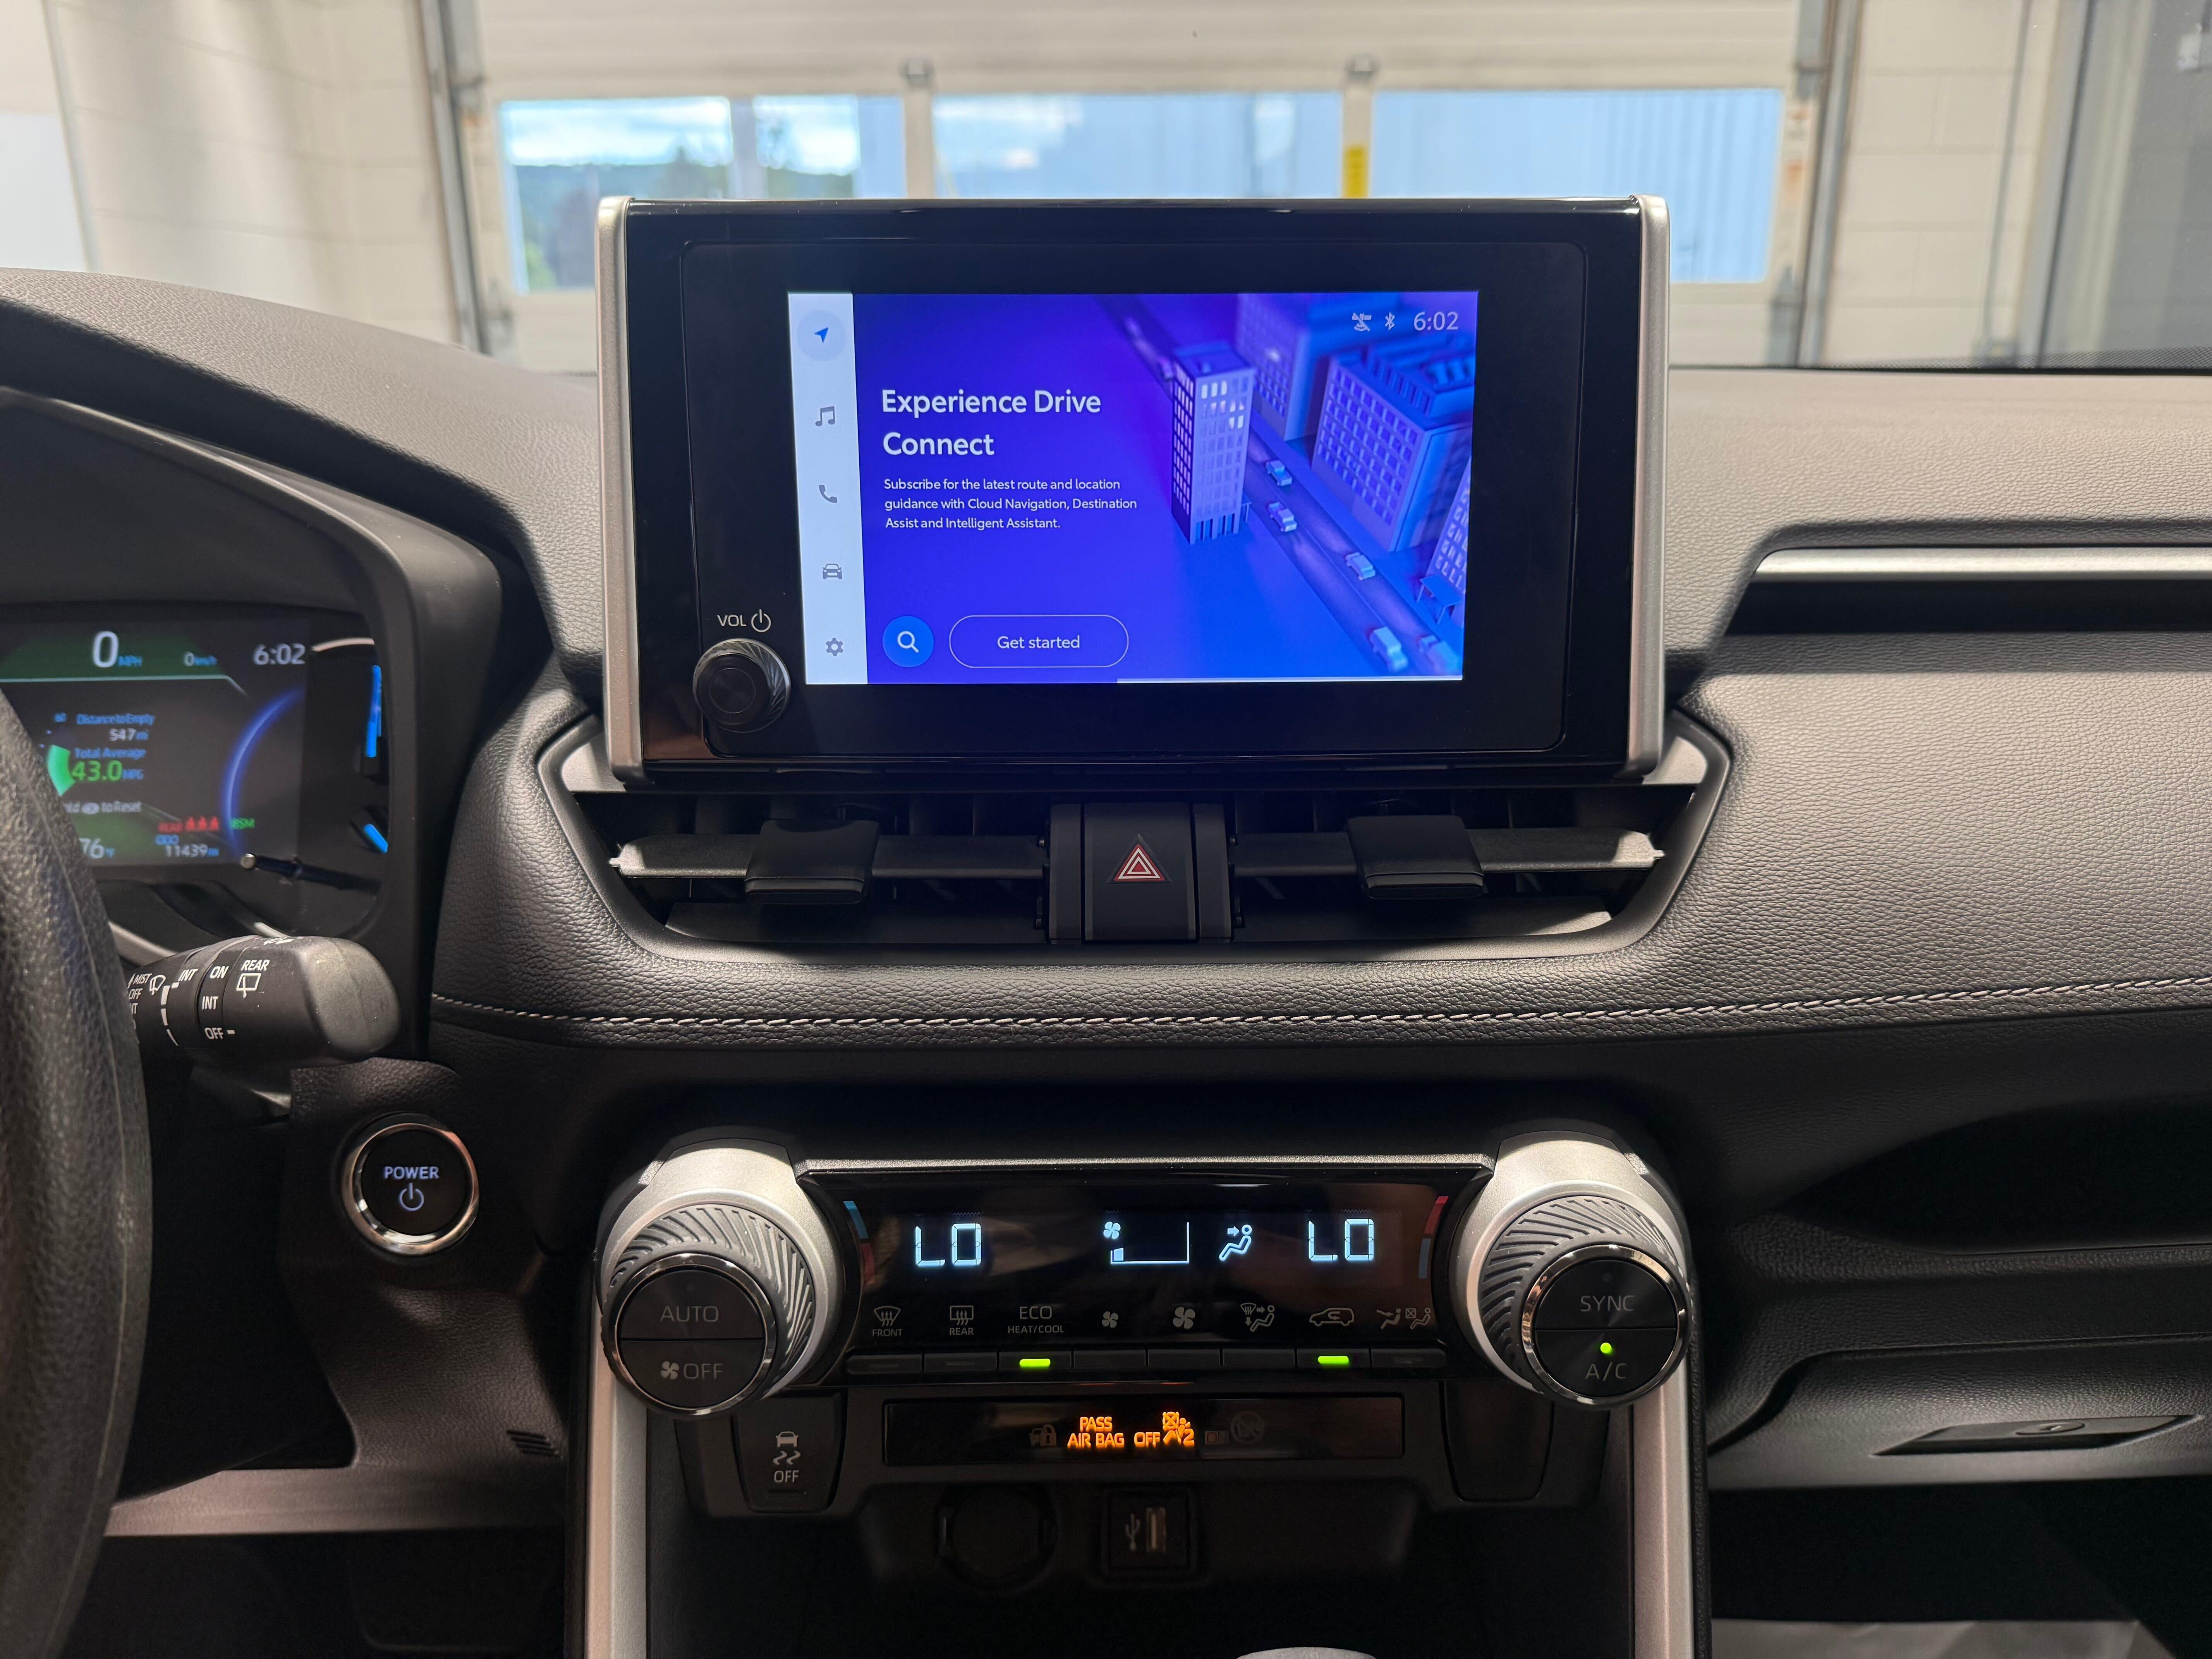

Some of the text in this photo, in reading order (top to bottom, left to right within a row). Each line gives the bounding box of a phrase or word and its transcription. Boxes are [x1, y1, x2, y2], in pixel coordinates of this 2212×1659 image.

[1413, 311, 1458, 331] 6:02
[883, 389, 1101, 418] Experience Drive
[883, 432, 994, 455] Connect
[884, 478, 1120, 489] Subscribe for the latest route and location
[885, 498, 1137, 511] guidance with Cloud Navigation, Destination
[886, 517, 1060, 530] Assist and Intelligent Assistant.
[717, 615, 747, 627] VOL
[998, 635, 1080, 648] Get started
[254, 643, 306, 665] 6:02
[240, 959, 270, 971] REAR
[132, 973, 152, 984] MIST
[178, 968, 199, 982] INT
[210, 966, 229, 979] ON
[129, 988, 143, 1000] OFF
[202, 996, 219, 1010] INT
[204, 1027, 224, 1039] OFF
[384, 1166, 440, 1180] POWER
[915, 1223, 982, 1267] LO
[1308, 1218, 1375, 1262] LO
[1580, 1295, 1635, 1312] SYNC
[660, 1306, 719, 1322] AUTO
[1019, 1305, 1053, 1319] ECO
[872, 1328, 903, 1336] FRONT
[949, 1328, 974, 1336] REAR
[1008, 1325, 1064, 1334] HEAT/COOL
[683, 1363, 723, 1379] OFF
[1585, 1363, 1626, 1381] A/C
[1080, 1416, 1112, 1432] PASS
[1067, 1432, 1091, 1448] AIR
[1096, 1432, 1124, 1448] BAG
[1134, 1432, 1160, 1447] OFF
[774, 1470, 799, 1483] OFF
